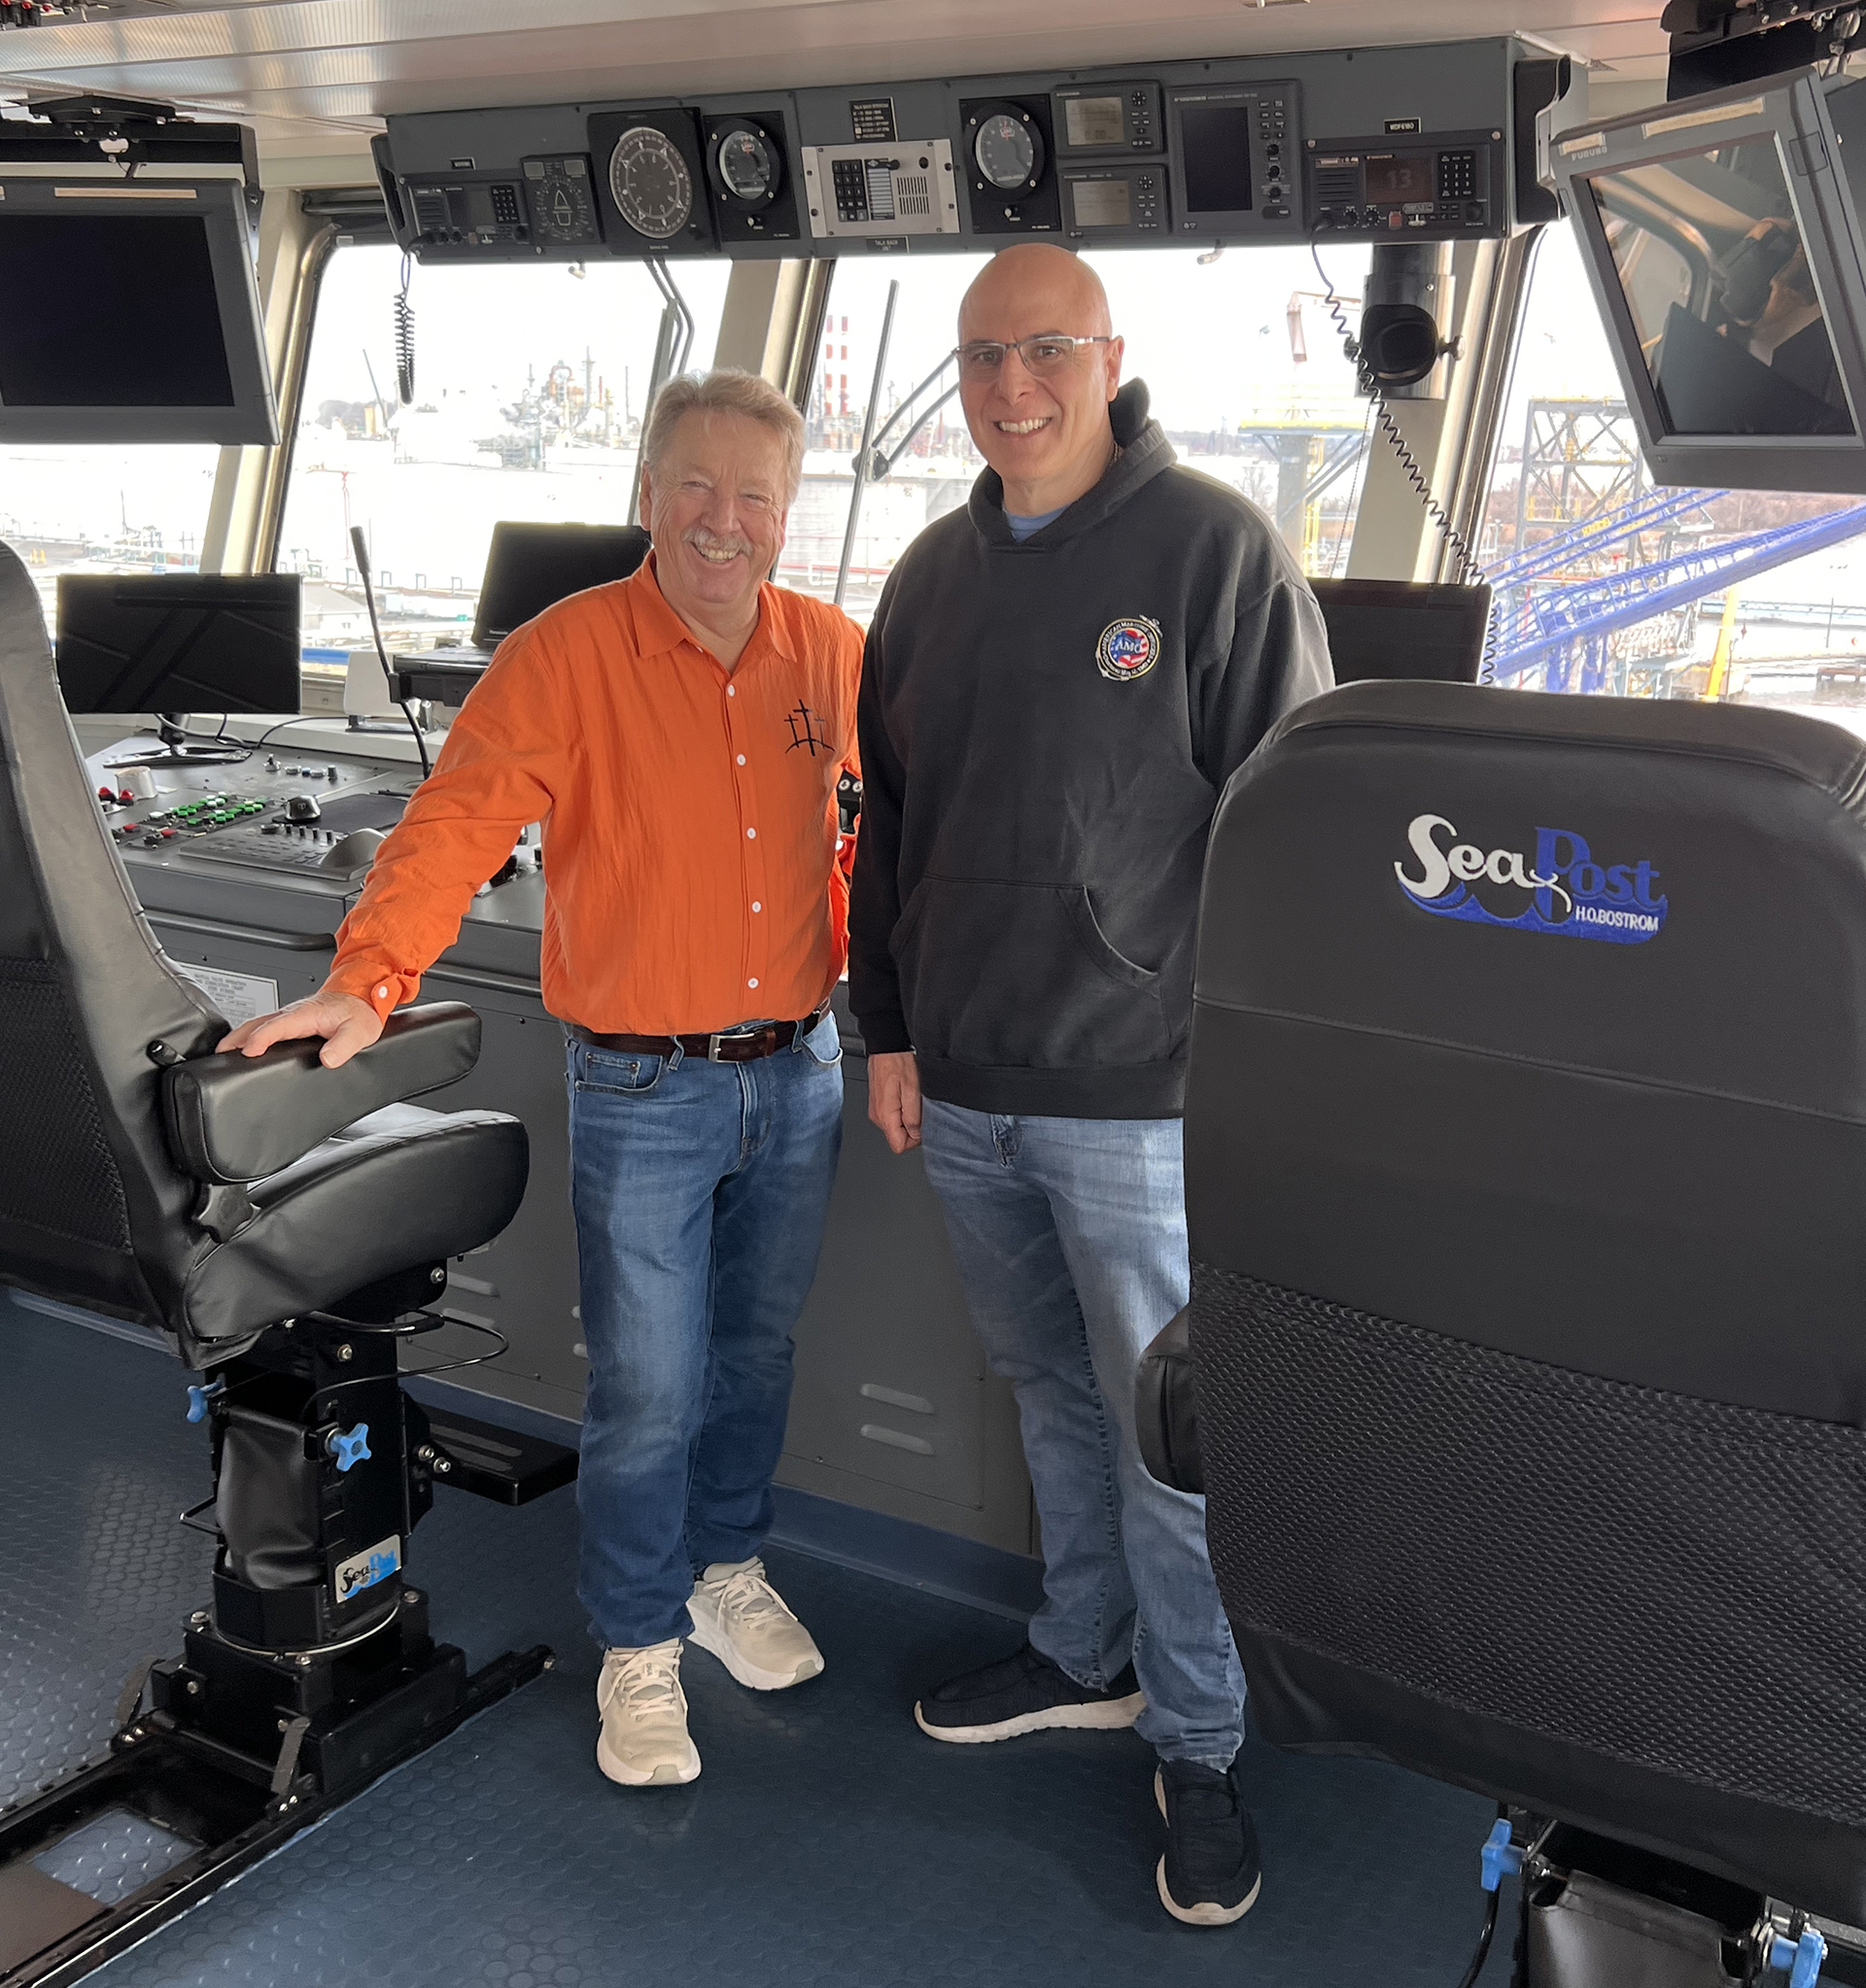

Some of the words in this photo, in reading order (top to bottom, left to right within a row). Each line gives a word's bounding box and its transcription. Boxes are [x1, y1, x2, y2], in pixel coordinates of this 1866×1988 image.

[1572, 147, 1607, 160] FURUNO
[1387, 168, 1413, 190] 13
[1116, 638, 1141, 654] AMO
